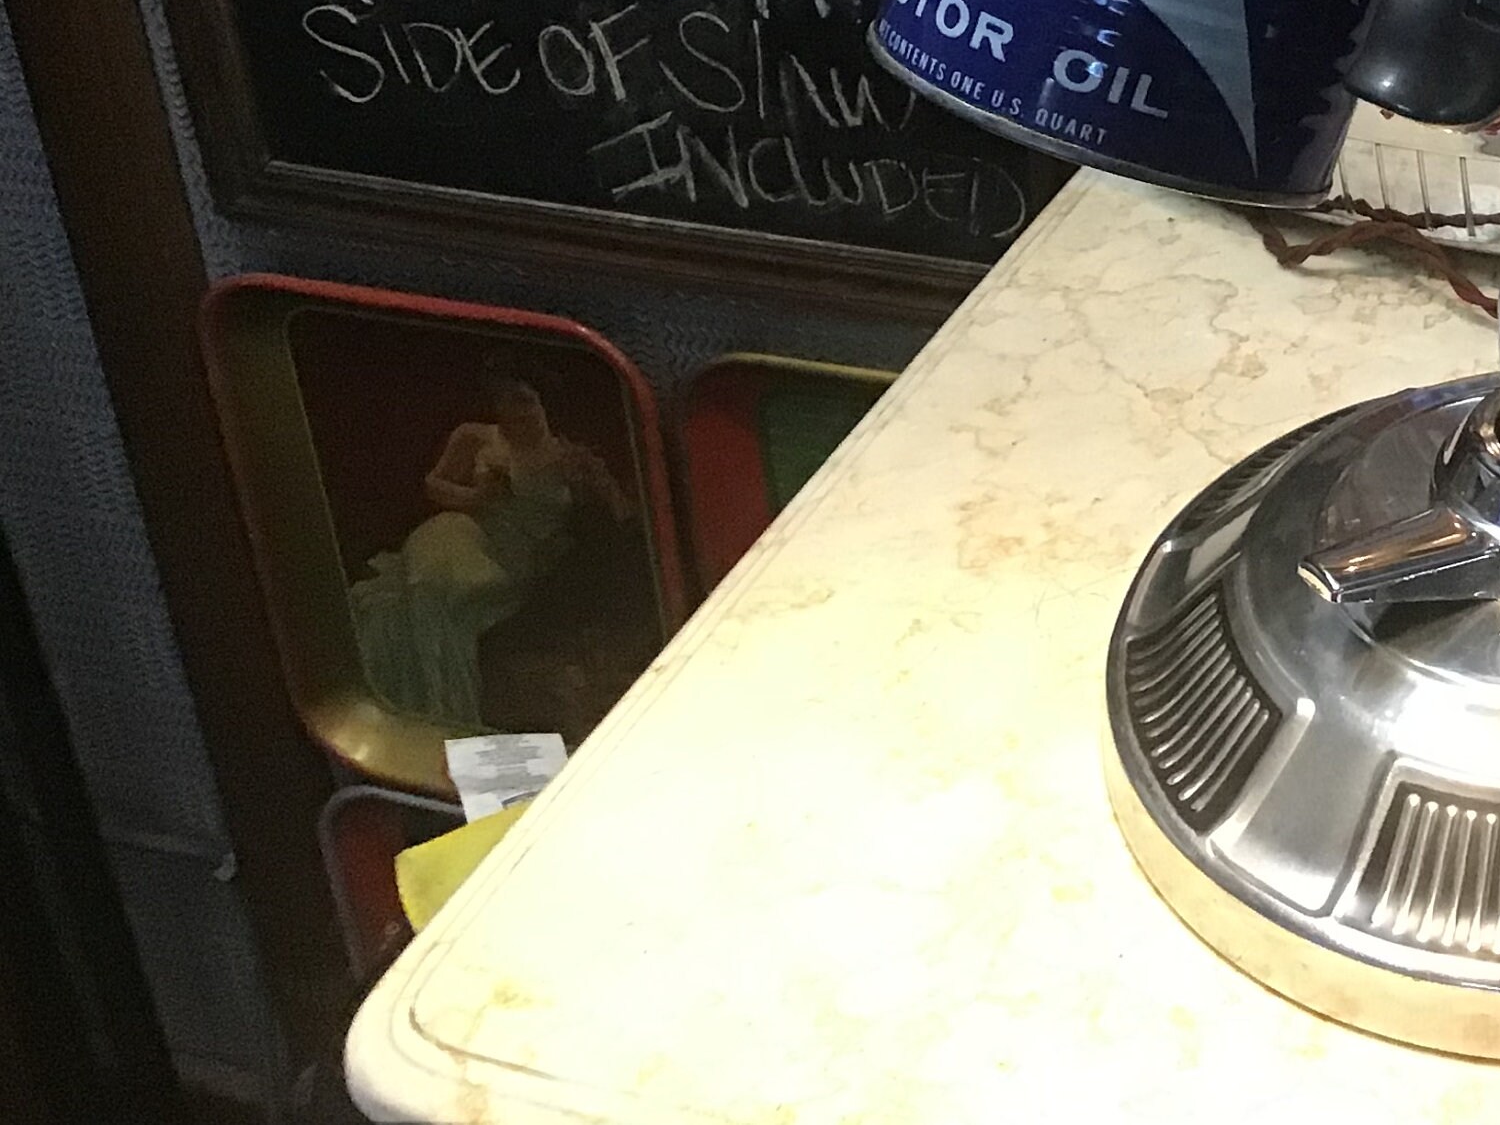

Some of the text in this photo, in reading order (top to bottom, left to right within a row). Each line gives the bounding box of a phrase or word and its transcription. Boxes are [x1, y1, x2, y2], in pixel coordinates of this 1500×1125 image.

[538, 4, 651, 101] OF
[887, 31, 948, 82] CONTENTS
[949, 70, 987, 102] ONE
[991, 90, 1025, 119] U.S.
[1034, 107, 1108, 146] QUART
[1052, 48, 1169, 120] OIL
[586, 111, 1028, 239] INCLUDED
